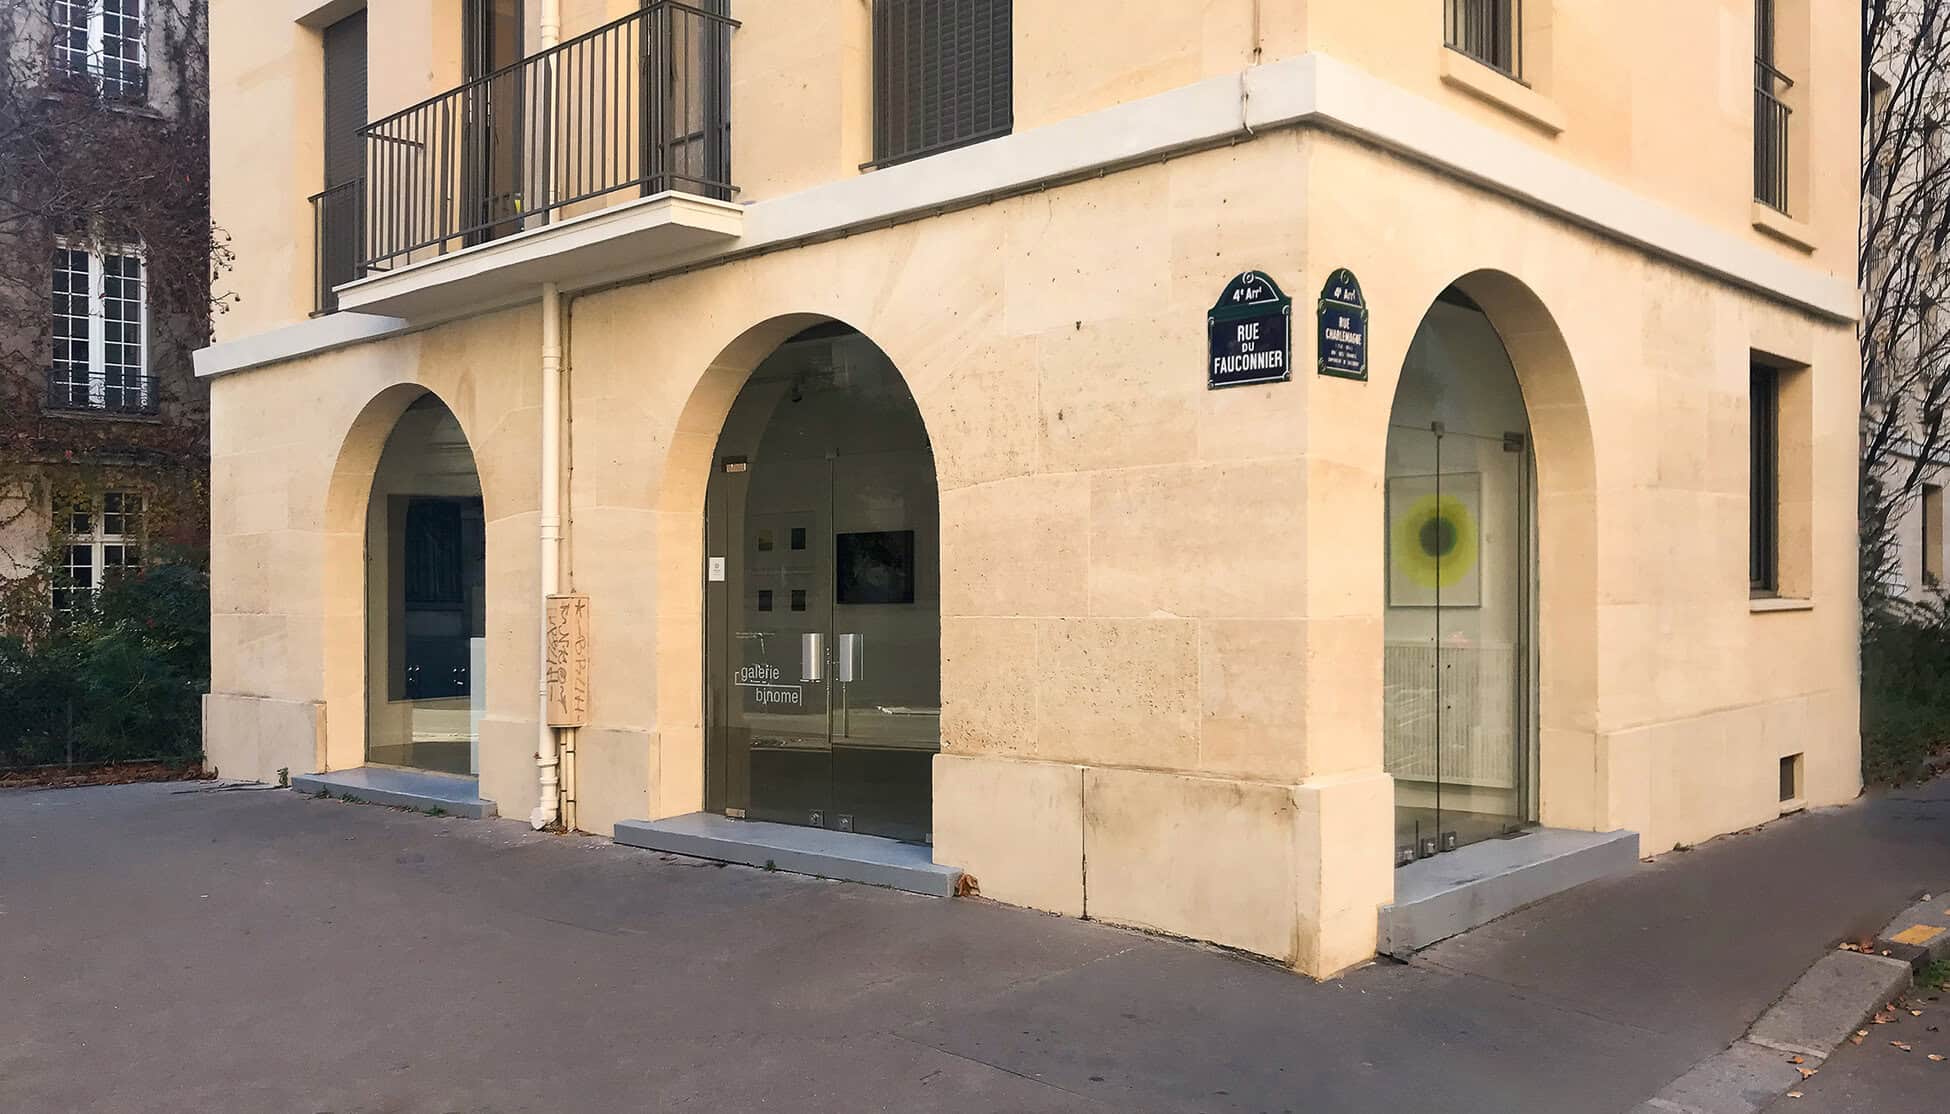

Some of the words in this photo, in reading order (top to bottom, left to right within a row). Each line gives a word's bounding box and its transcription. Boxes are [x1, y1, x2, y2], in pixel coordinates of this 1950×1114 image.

[1237, 322, 1260, 342] RUE
[1338, 316, 1350, 330] RUE
[1241, 341, 1255, 353] DU
[1214, 350, 1283, 374] FAUCONNIER
[741, 664, 780, 682] galerie
